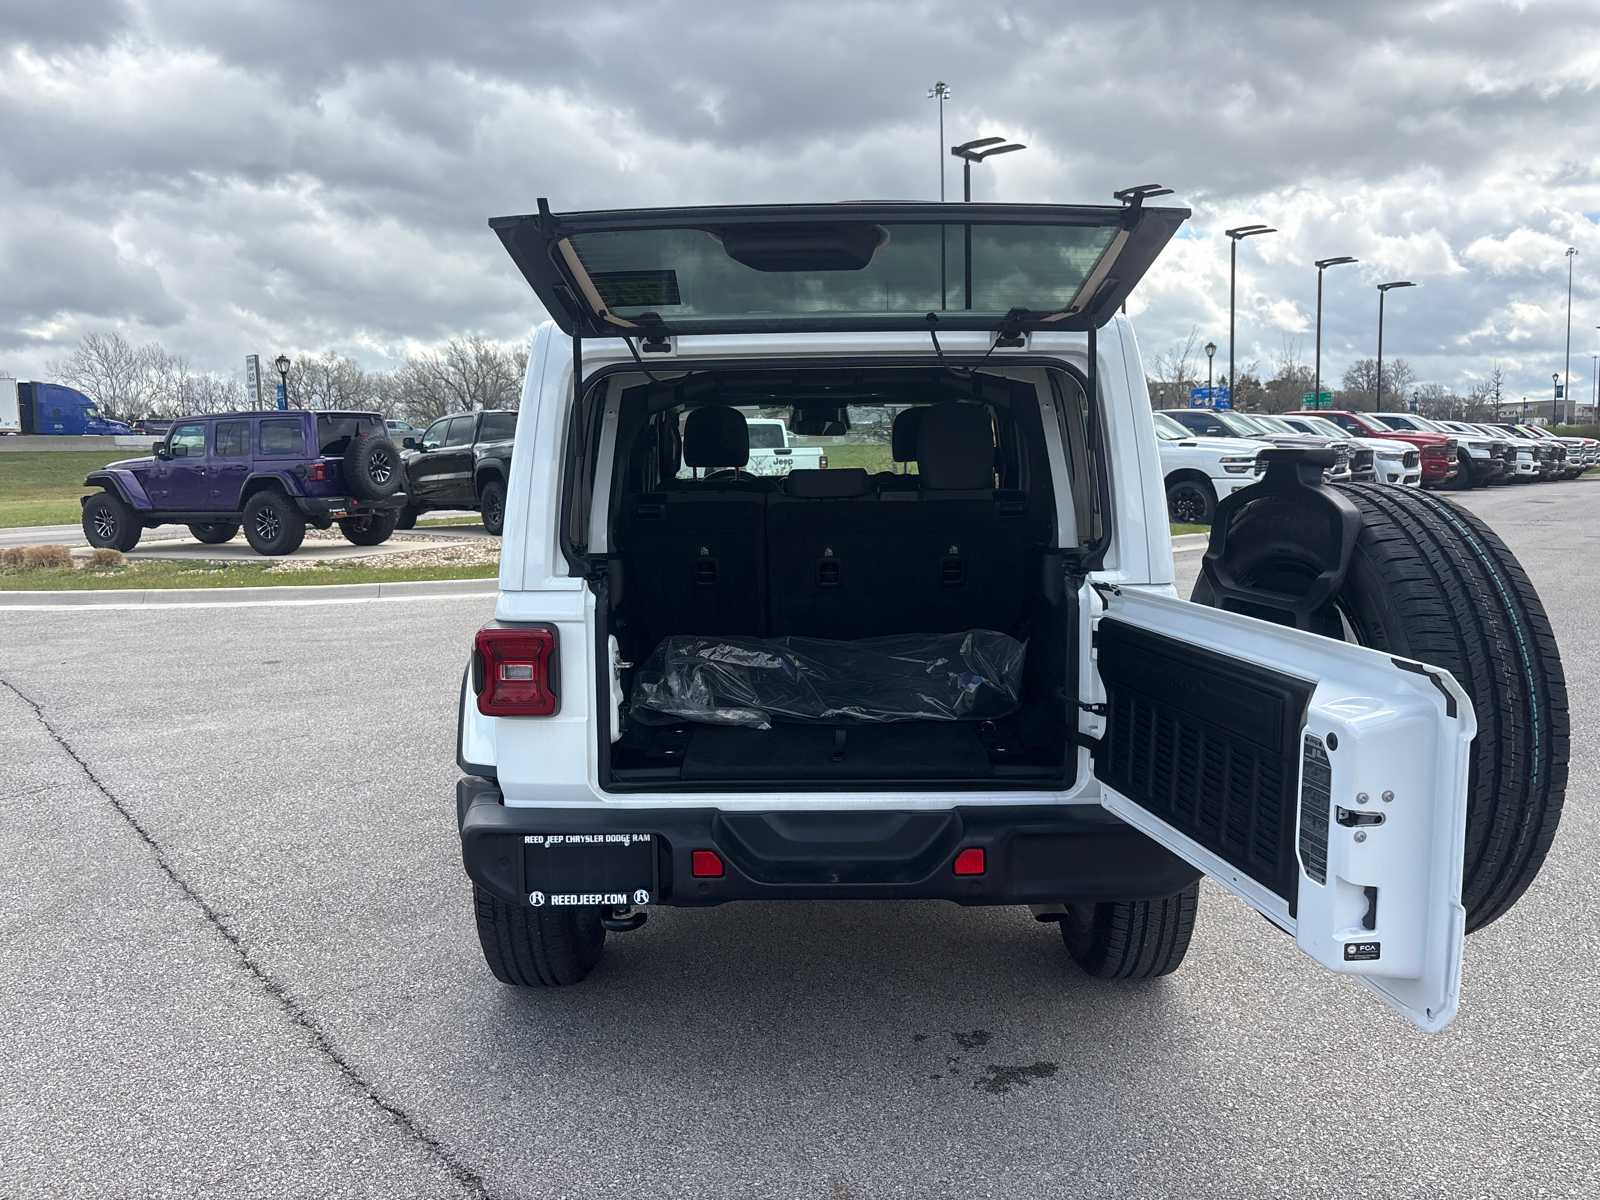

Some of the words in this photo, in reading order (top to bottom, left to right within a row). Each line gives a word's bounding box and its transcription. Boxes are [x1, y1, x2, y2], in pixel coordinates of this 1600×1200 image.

[773, 457, 793, 466] Jeep
[524, 835, 544, 844] REED
[546, 835, 564, 844] JEEP
[565, 834, 604, 843] CHRYSLER
[605, 834, 631, 843] DODGE
[632, 833, 651, 842] RAM
[551, 893, 627, 906] REEDJEEP.COM
